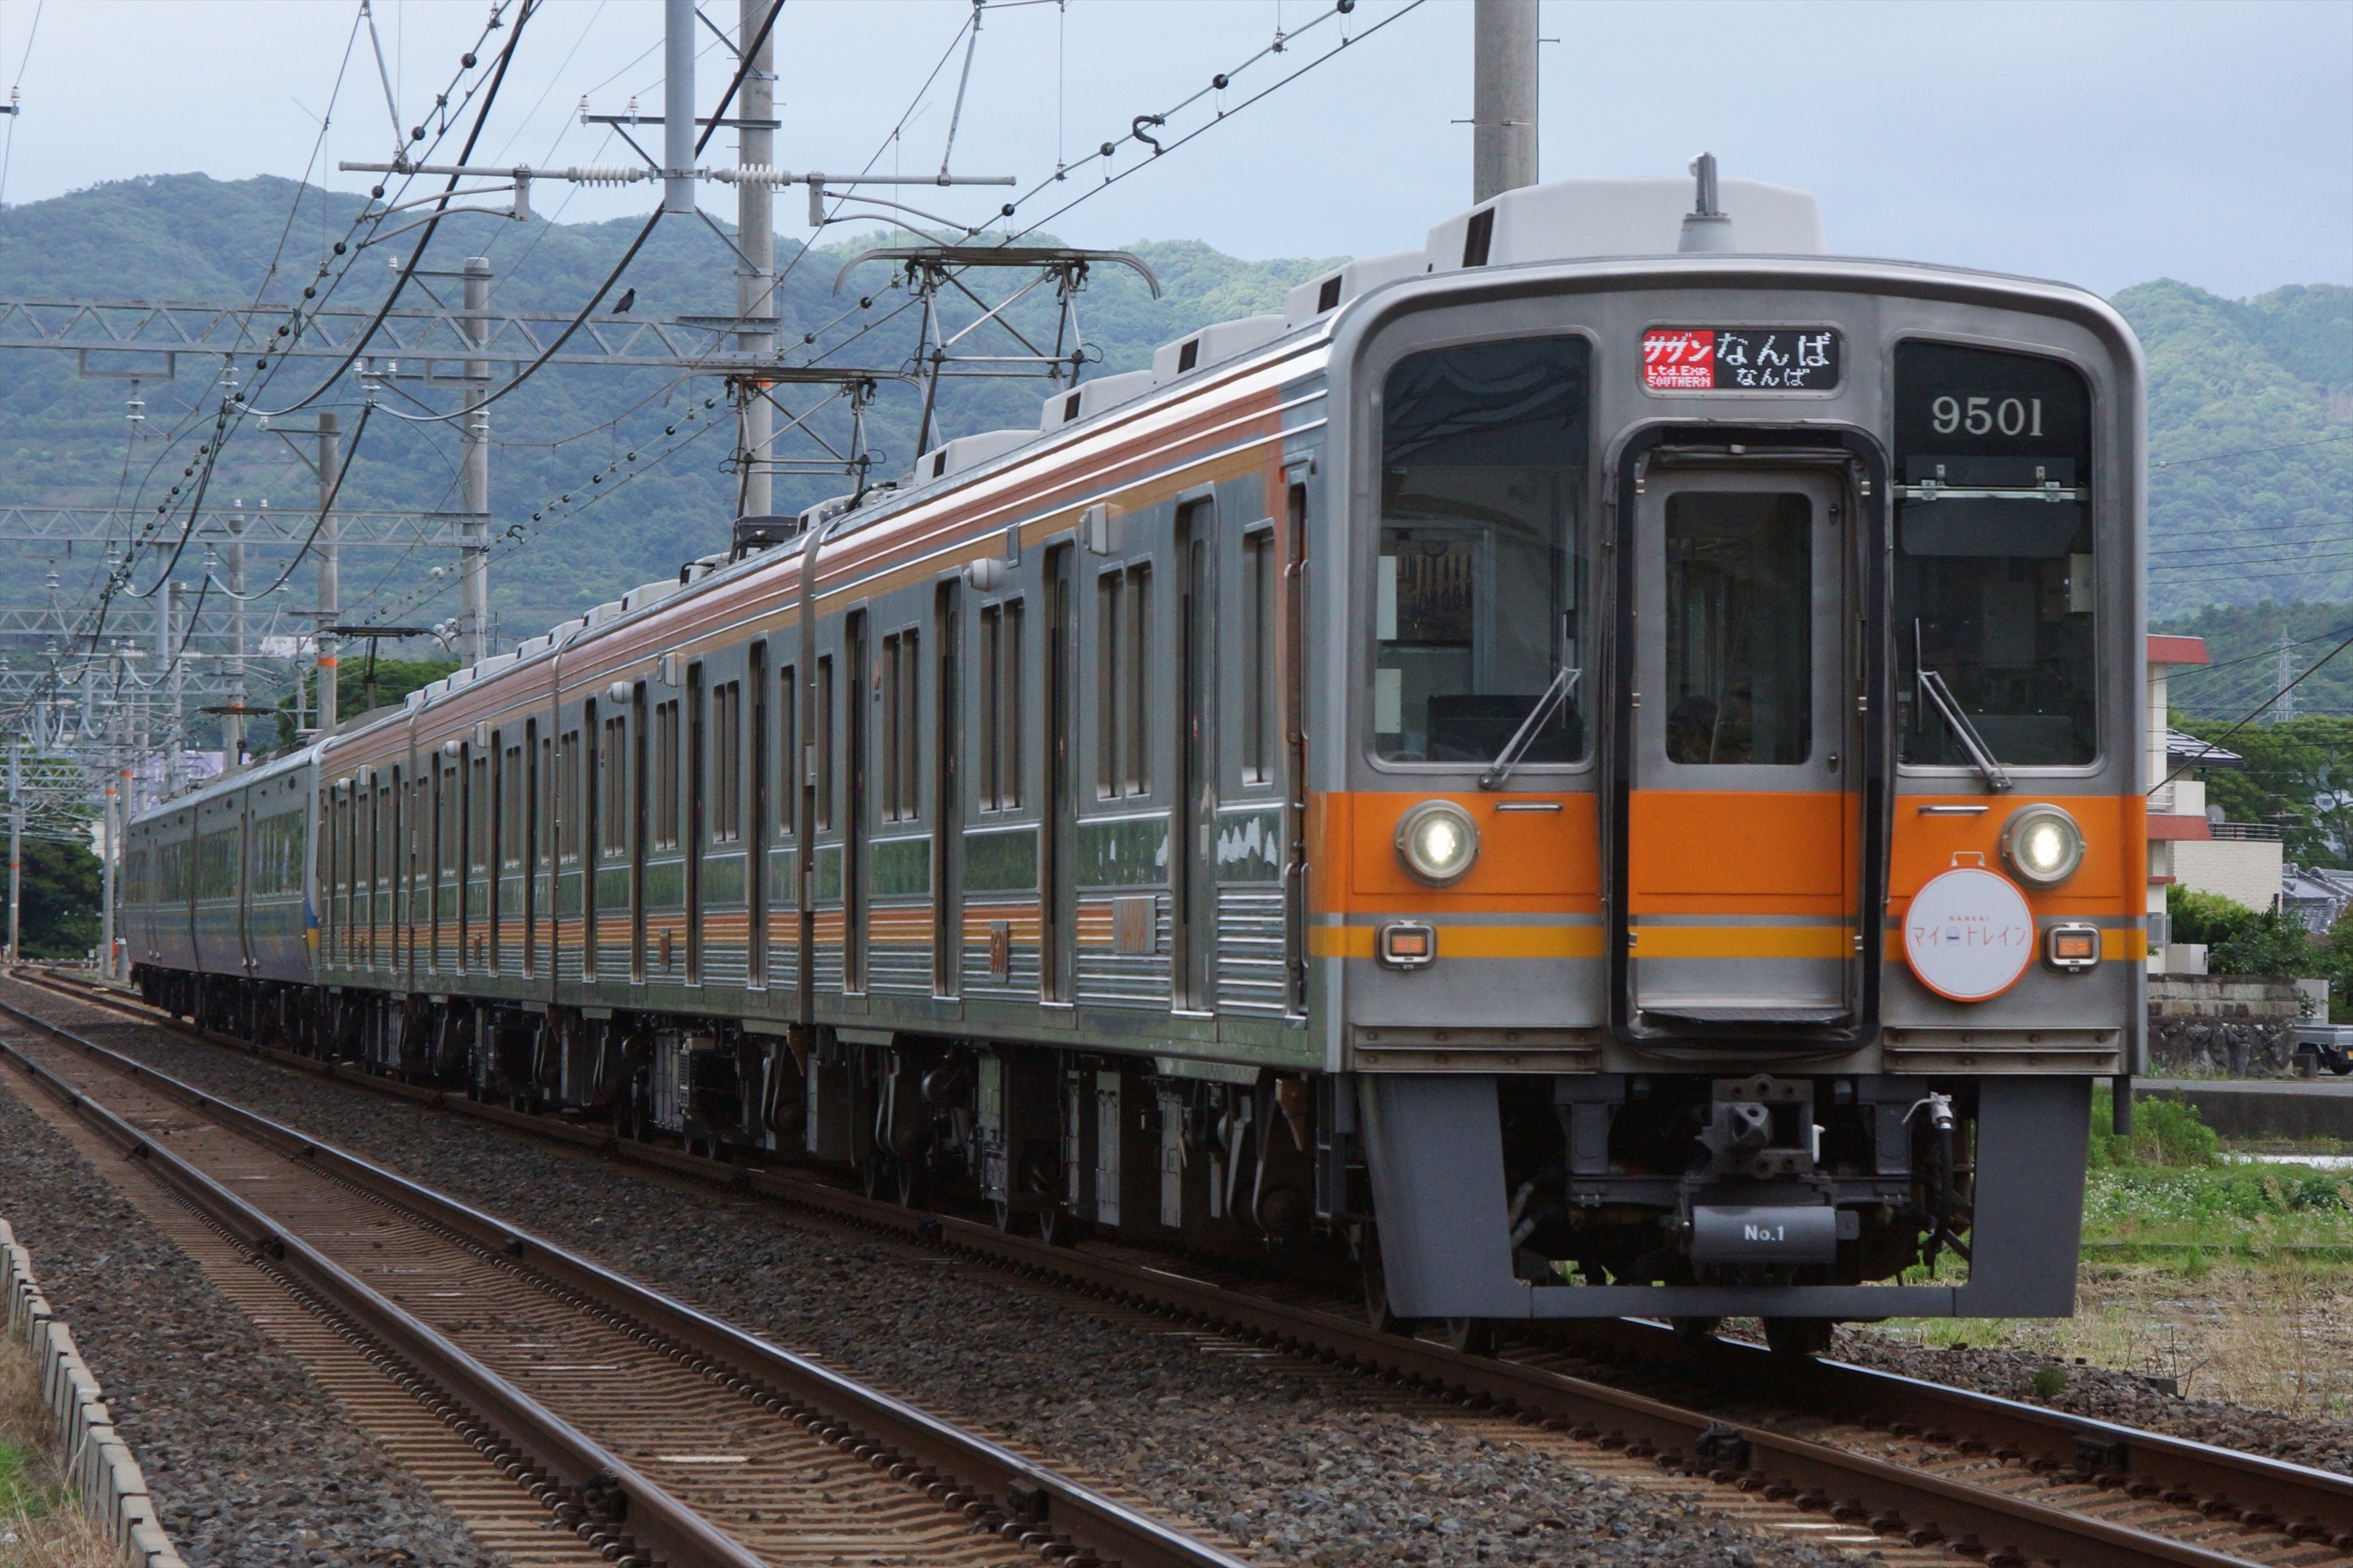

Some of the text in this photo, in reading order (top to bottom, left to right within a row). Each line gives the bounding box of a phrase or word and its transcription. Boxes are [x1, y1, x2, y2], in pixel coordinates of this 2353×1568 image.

[1643, 333, 1712, 363] サザン
[1716, 332, 1833, 367] なんば
[1646, 377, 1711, 388] SOUTHERN
[1736, 368, 1811, 387] なんば
[1932, 396, 2043, 436] 9501
[1744, 1224, 1785, 1242] No.1
